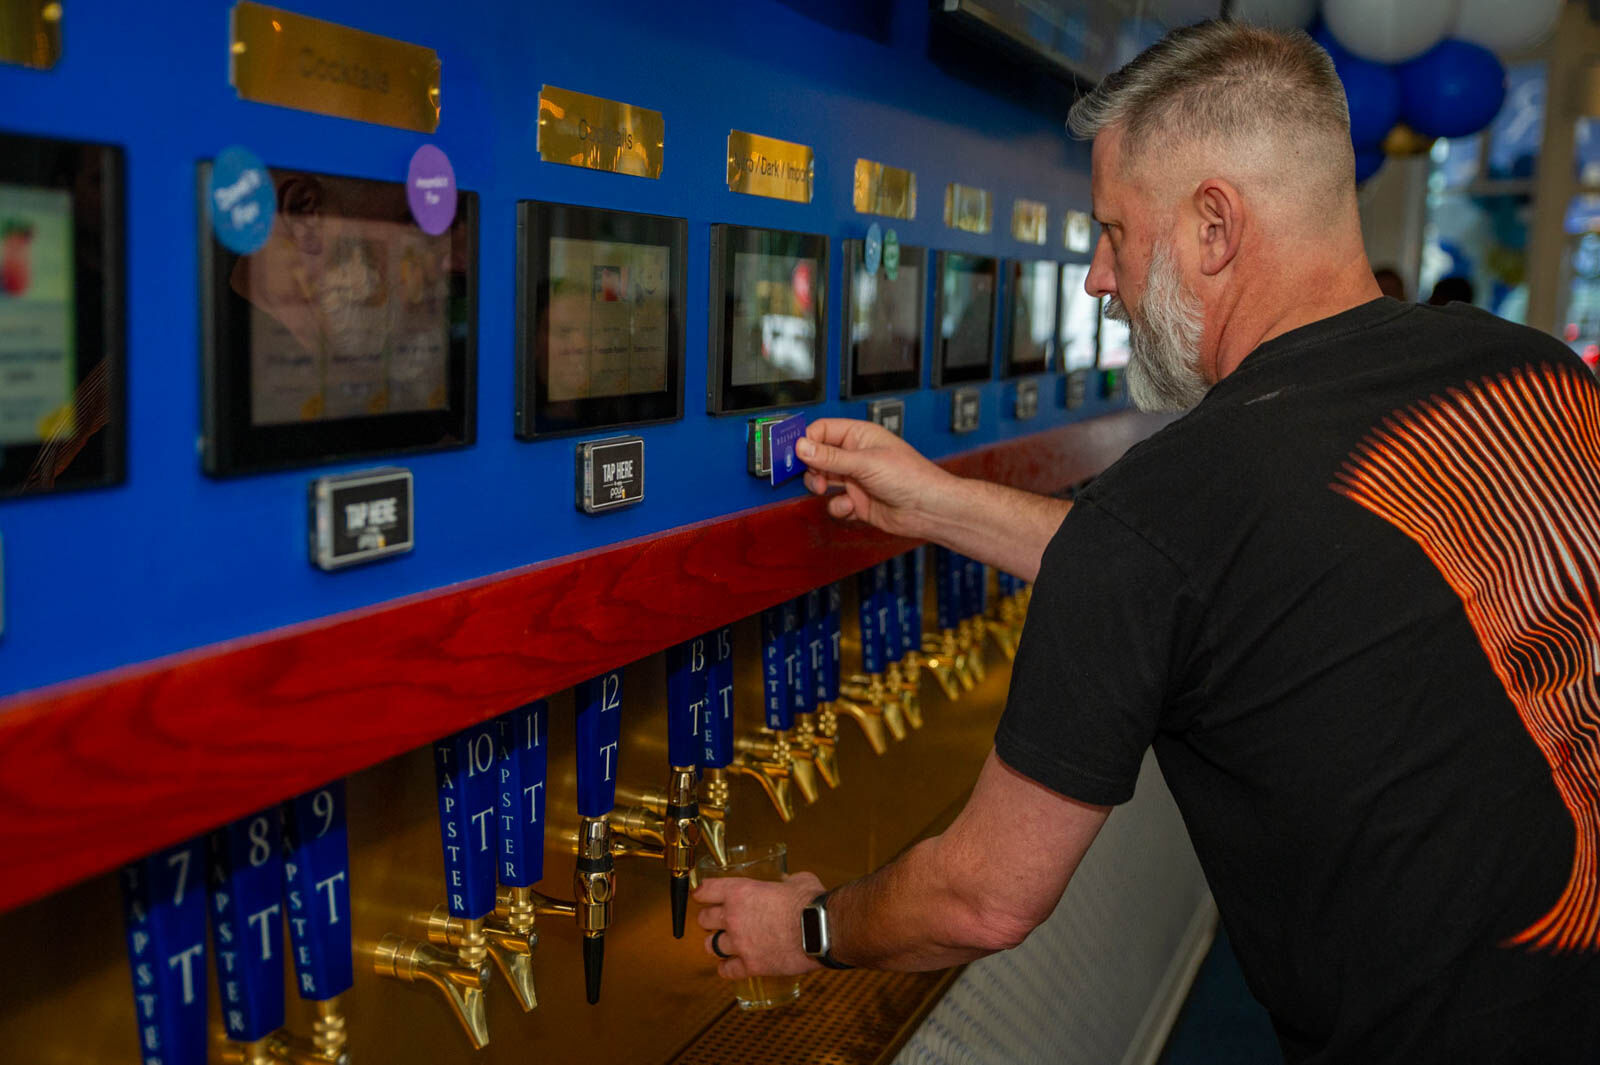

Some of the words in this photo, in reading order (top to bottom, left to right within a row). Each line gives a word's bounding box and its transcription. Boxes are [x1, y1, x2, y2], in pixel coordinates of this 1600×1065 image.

[761, 156, 780, 178] Dark
[602, 463, 616, 483] TAP
[616, 459, 634, 481] HERE
[691, 639, 705, 673] 13
[784, 653, 796, 686] T
[600, 673, 621, 713] 12
[719, 685, 733, 720] T
[527, 711, 541, 750] 11
[689, 700, 704, 737] T
[467, 732, 494, 778] 10
[600, 740, 618, 782] T
[312, 790, 334, 839] 9
[496, 720, 517, 878] TAPSTER
[524, 780, 544, 825] T
[249, 817, 271, 867] 8
[438, 747, 465, 912] TAPSTER
[472, 806, 495, 852] T
[168, 849, 192, 906] 7
[315, 871, 345, 926] T
[247, 903, 280, 961] T
[168, 943, 204, 1005] T
